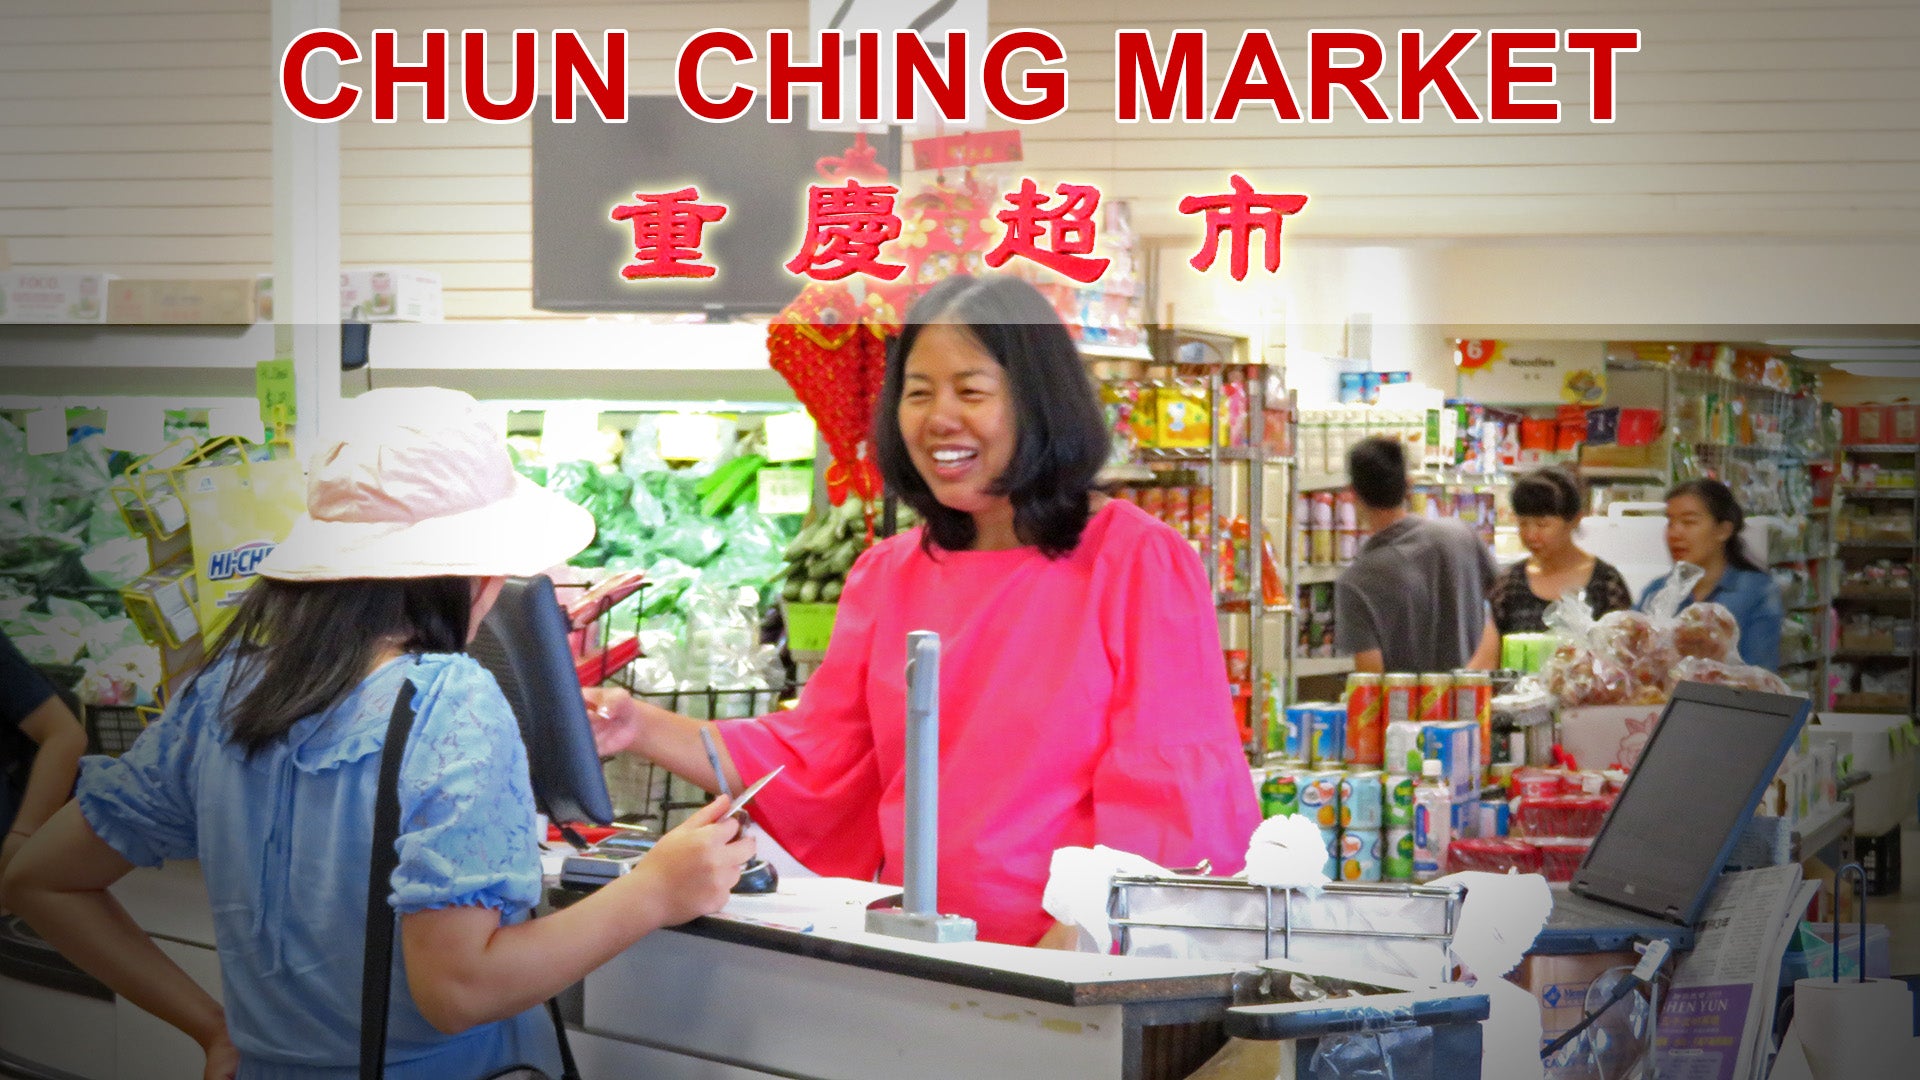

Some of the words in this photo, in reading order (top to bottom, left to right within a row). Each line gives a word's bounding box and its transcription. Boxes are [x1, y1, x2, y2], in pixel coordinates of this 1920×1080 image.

[1467, 338, 1483, 359] 6
[1509, 358, 1555, 367] Noodles
[1699, 999, 1729, 1012] YUN
